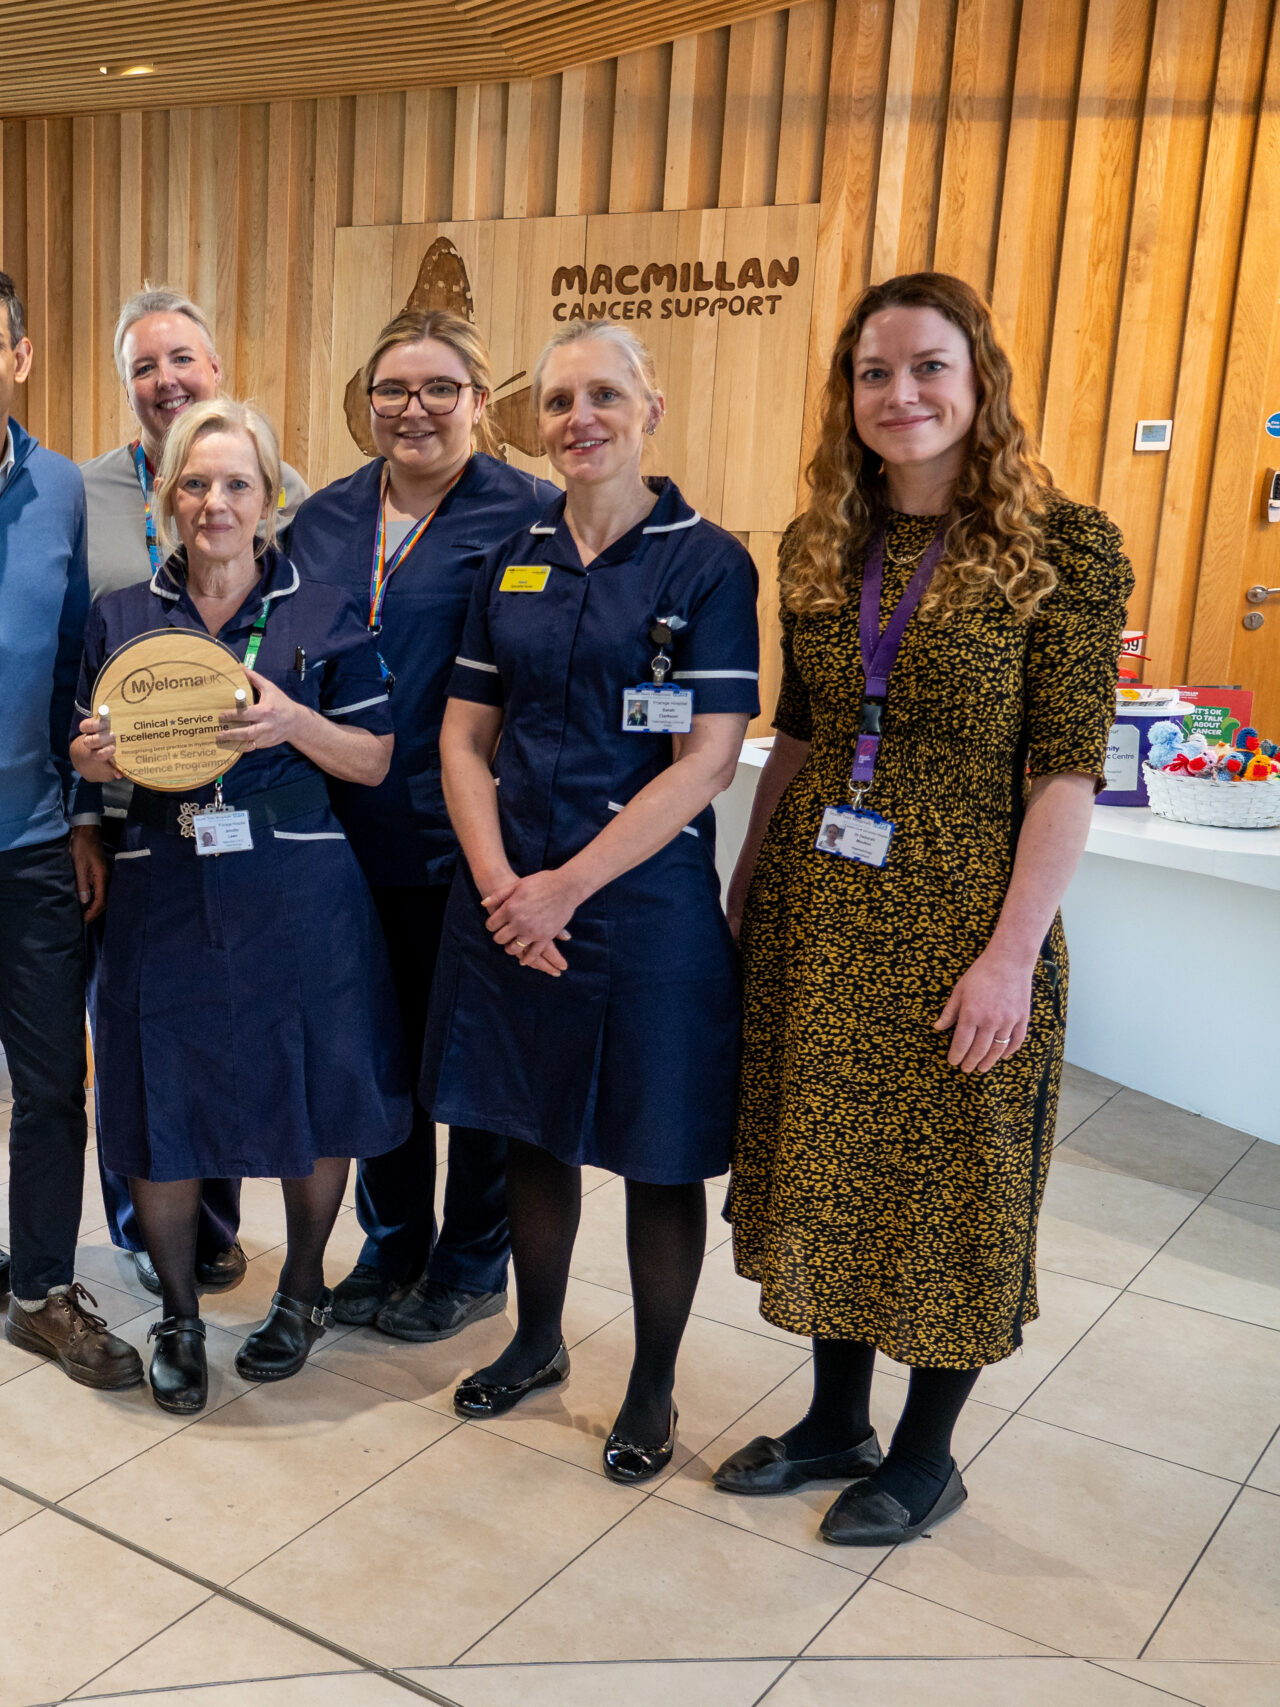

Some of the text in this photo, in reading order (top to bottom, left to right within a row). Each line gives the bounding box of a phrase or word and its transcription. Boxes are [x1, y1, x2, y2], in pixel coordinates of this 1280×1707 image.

[551, 256, 800, 297] MACMILLAN
[552, 294, 782, 322] CANCER SUPPORT
[120, 724, 229, 743] Excellence Programme
[133, 714, 213, 730] Clinical Service
